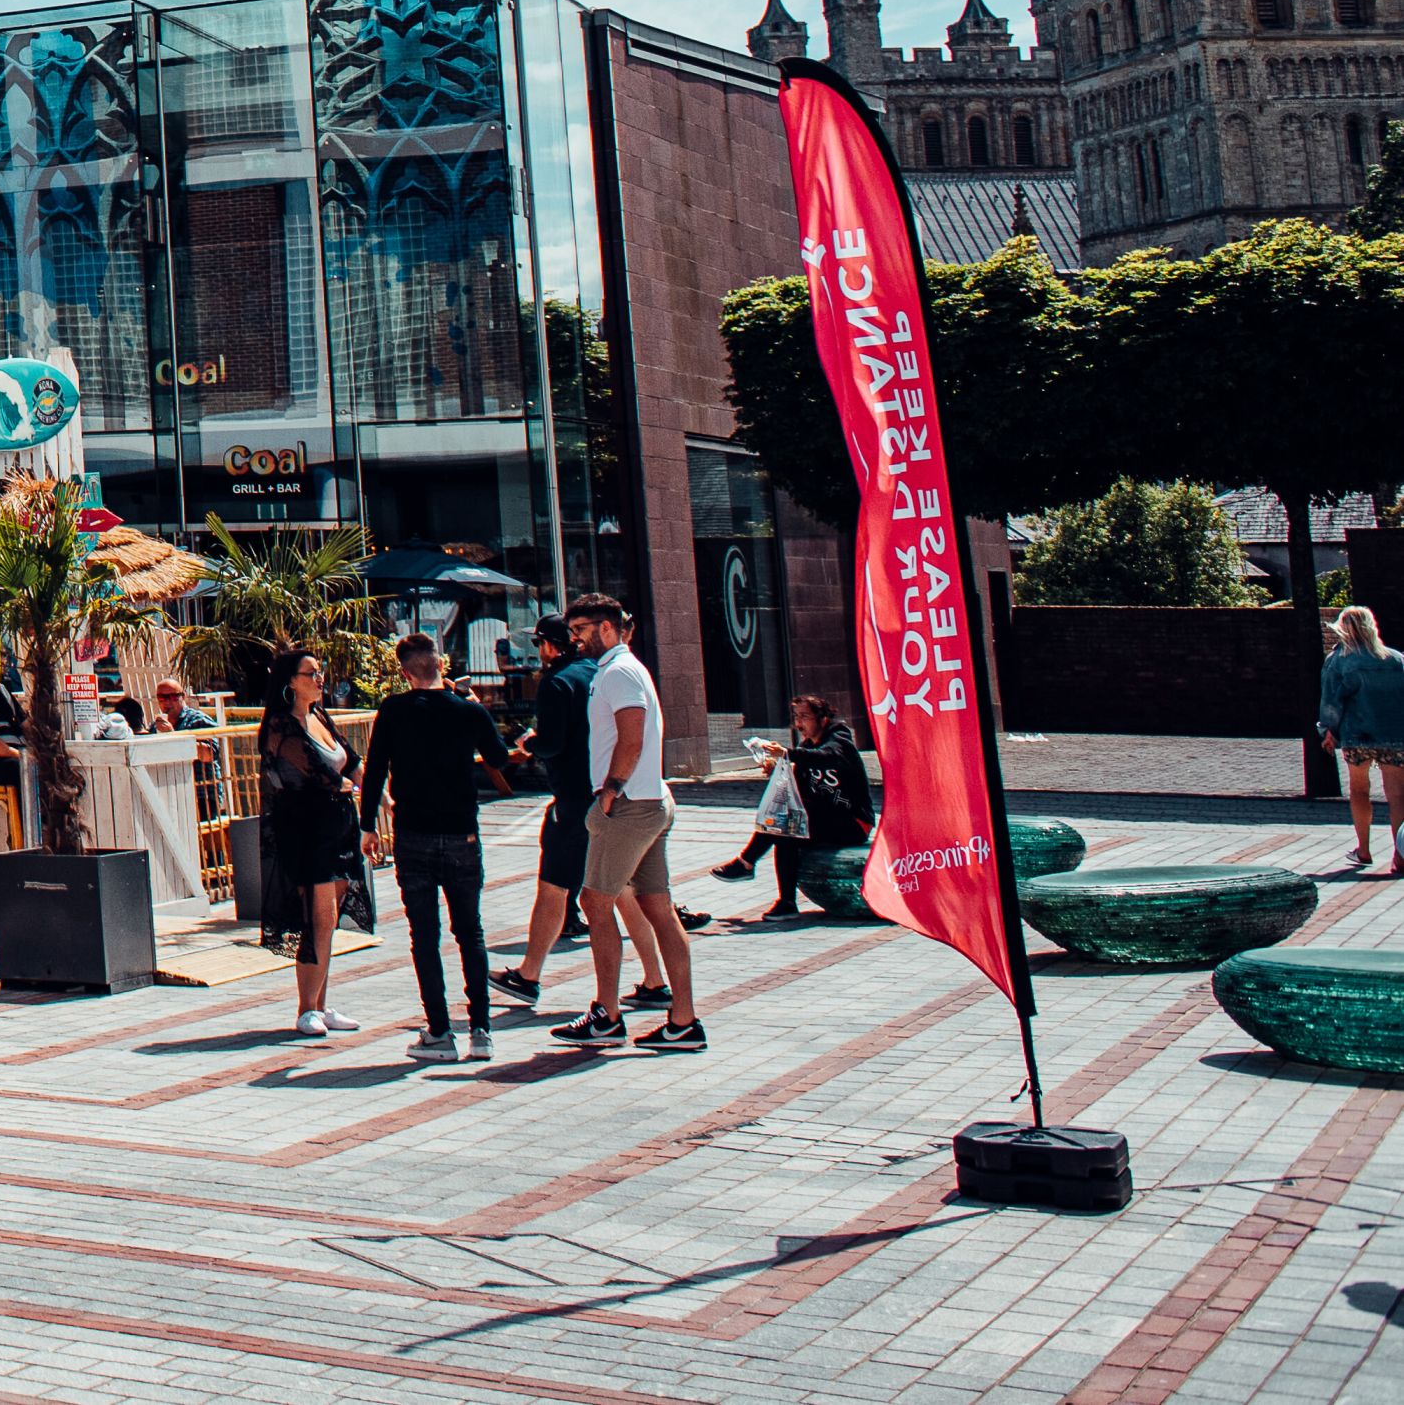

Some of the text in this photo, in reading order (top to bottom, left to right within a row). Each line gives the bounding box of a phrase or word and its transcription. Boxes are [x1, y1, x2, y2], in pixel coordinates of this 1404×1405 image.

[155, 354, 227, 386] Coal
[223, 440, 308, 477] Coal
[232, 483, 264, 494] GRILL
[276, 483, 300, 493] BAR
[70, 675, 90, 683] PLEASE
